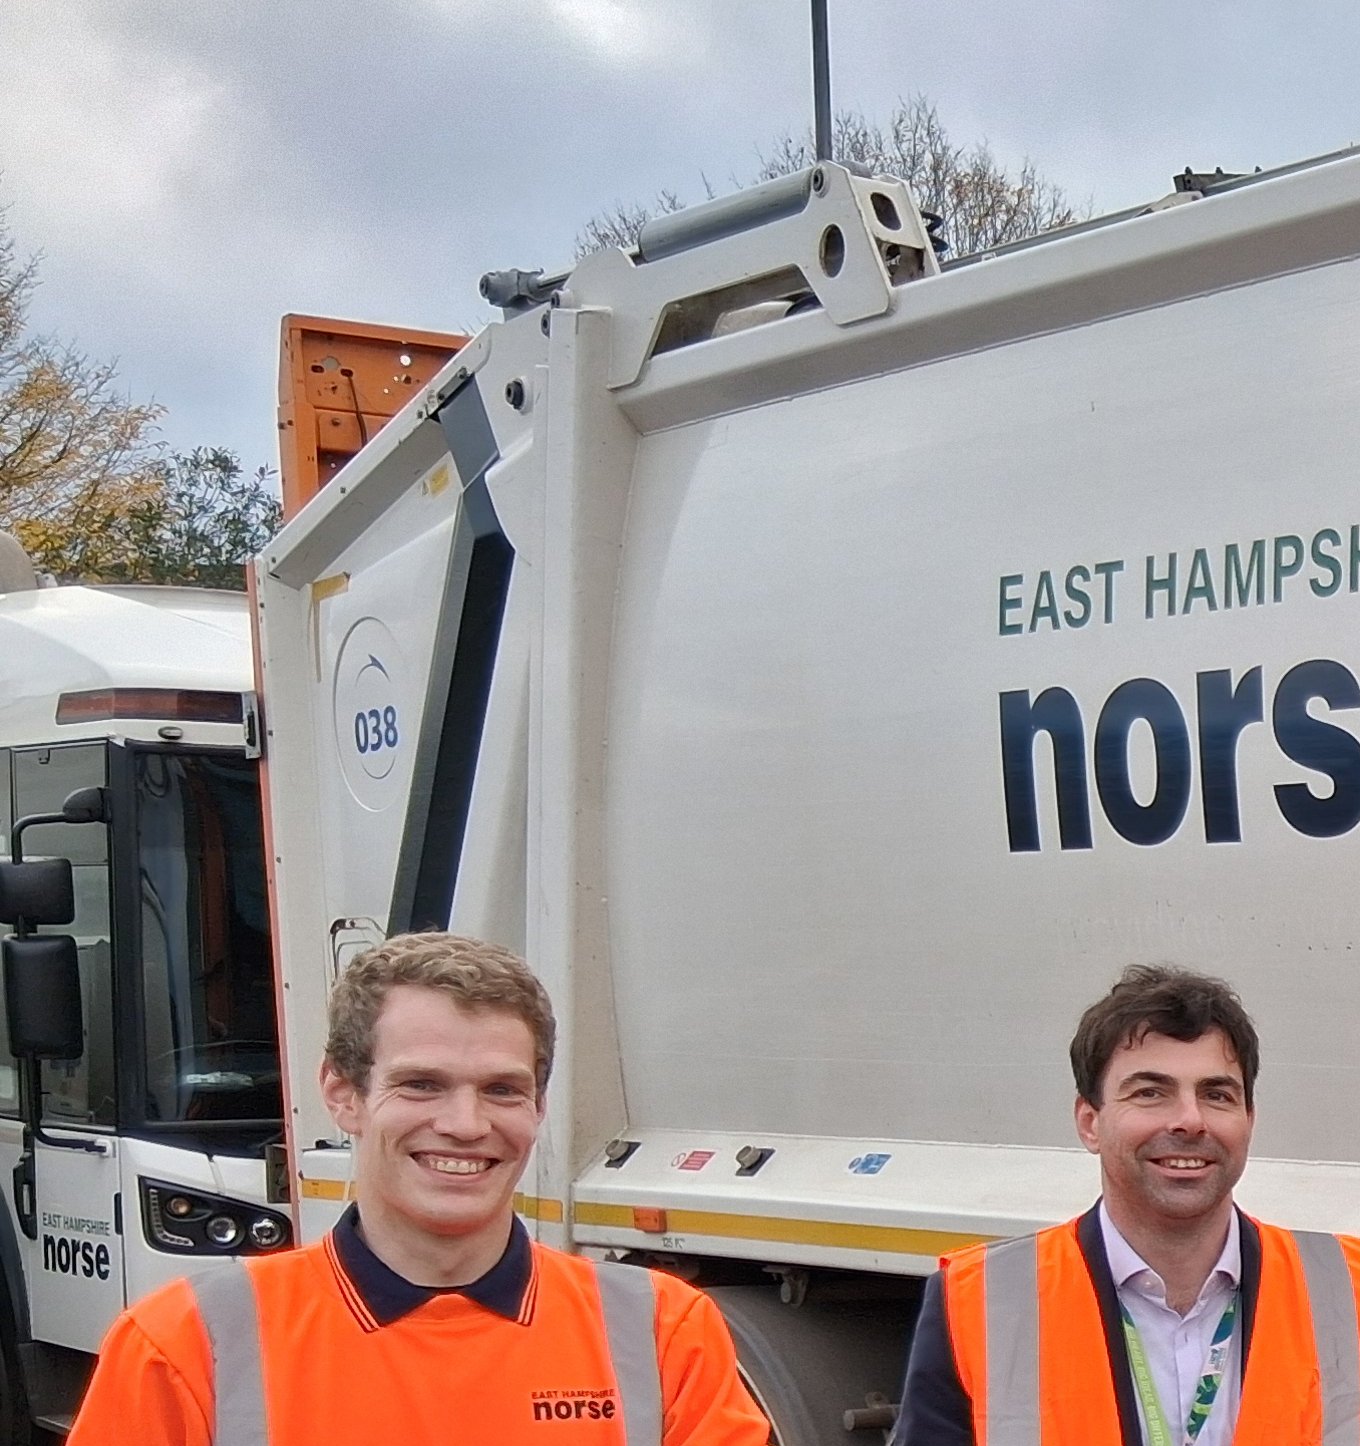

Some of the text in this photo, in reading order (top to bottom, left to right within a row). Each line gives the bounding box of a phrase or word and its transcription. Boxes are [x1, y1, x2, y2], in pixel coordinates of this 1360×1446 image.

[999, 559, 1124, 636] EAST
[355, 705, 398, 754] 038
[42, 1212, 111, 1237] EAST HAMPSHIRE
[43, 1233, 110, 1281] norse
[531, 1388, 615, 1400] EAST HAMPSHIRE
[533, 1400, 616, 1420] norse
